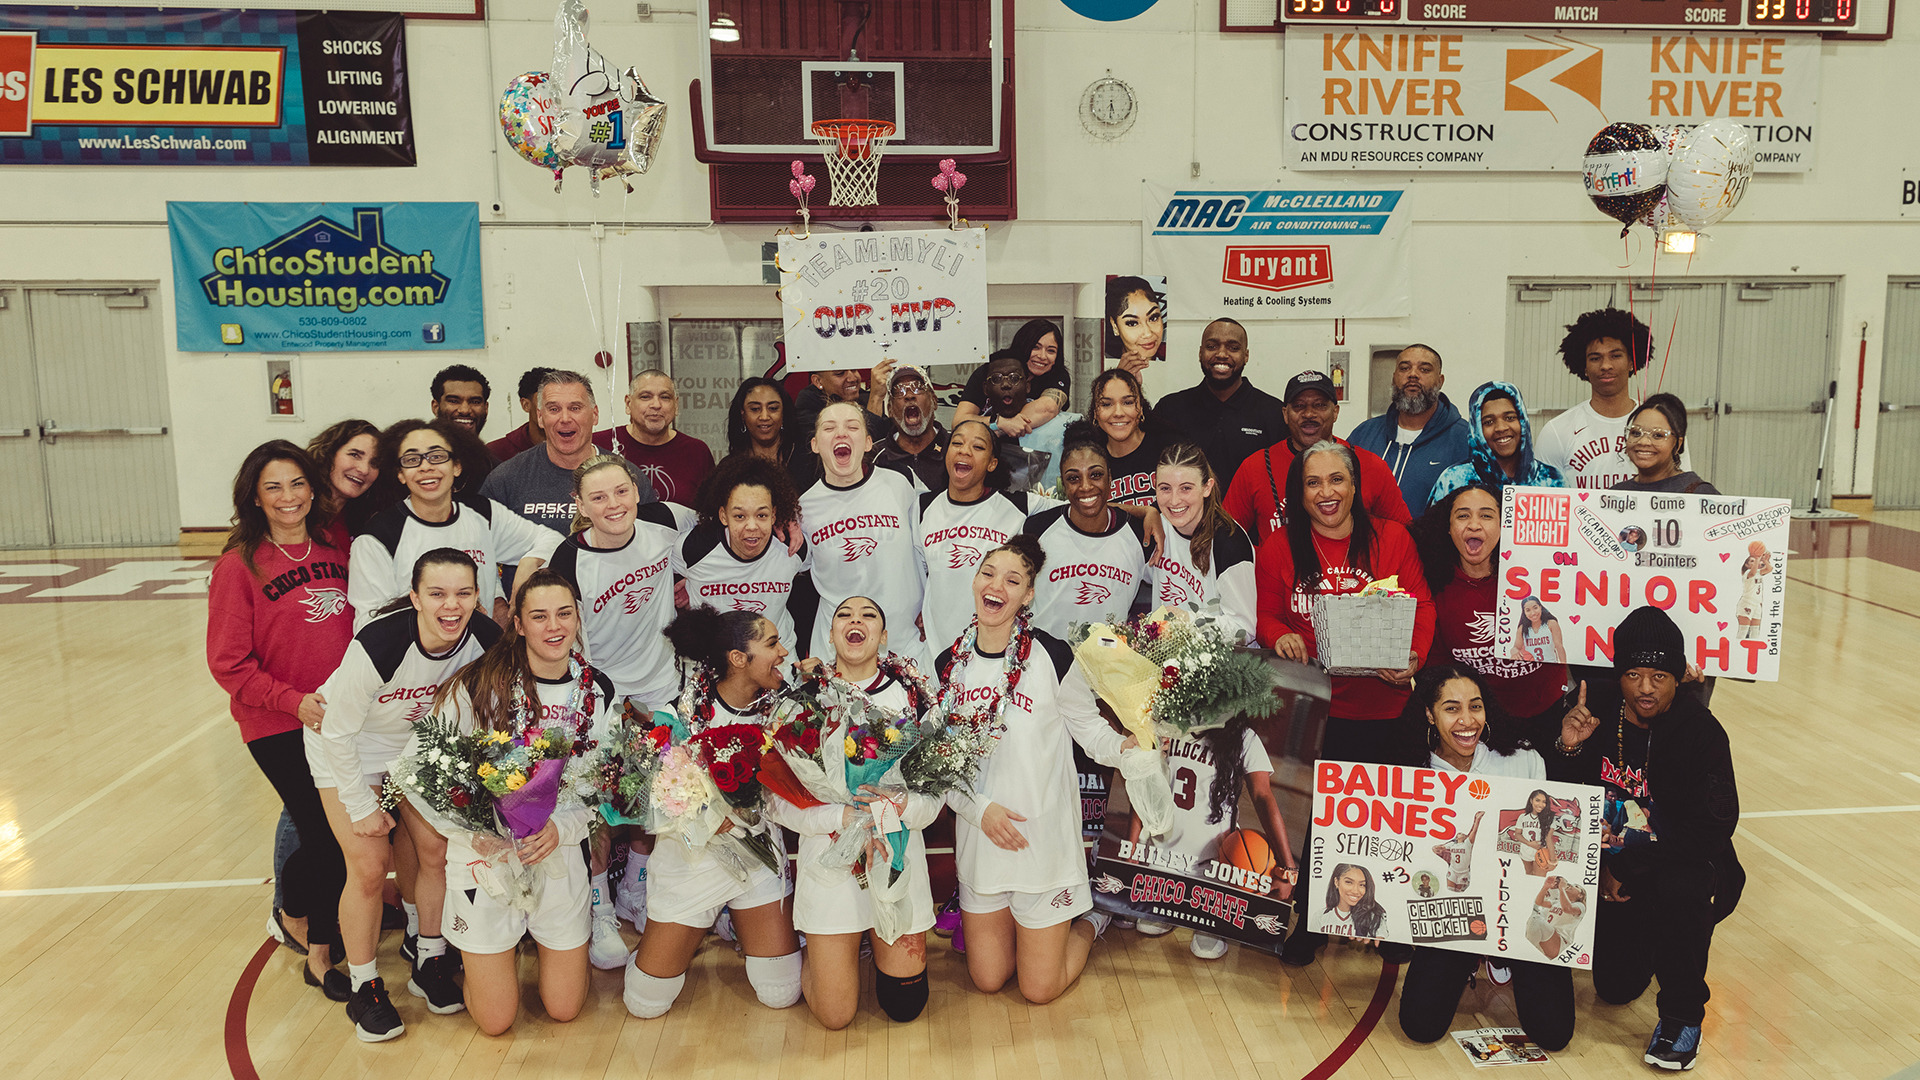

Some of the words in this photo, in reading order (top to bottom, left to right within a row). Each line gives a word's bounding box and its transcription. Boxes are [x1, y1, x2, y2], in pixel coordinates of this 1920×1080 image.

[1424, 4, 1466, 19] SCORE
[1555, 6, 1598, 20] MATCH
[1684, 8, 1726, 22] SCORE
[322, 40, 382, 56] SHOCKS
[1323, 33, 1464, 72] KNIFE
[1650, 36, 1786, 75] KNIFE
[44, 68, 103, 103] LES
[113, 69, 272, 106] SCHWAB
[327, 71, 382, 86] LIFTING
[1321, 78, 1464, 116] RIVER
[1648, 80, 1784, 118] RIVER
[318, 101, 397, 116] LOWERING
[583, 98, 620, 120] YOU'RE
[316, 130, 404, 145] ALIGNMENT
[589, 110, 626, 150] #1
[1291, 123, 1494, 141] CONSTRUCTION
[79, 134, 247, 151] www.LesSchwab.com
[1301, 152, 1317, 162] AN
[1321, 152, 1348, 162] MDU
[1351, 152, 1423, 162] RESOURCES
[1426, 152, 1484, 162] COMPANY
[1754, 152, 1801, 163] OMPANY
[1156, 199, 1247, 228] MAC
[1263, 195, 1383, 209] McCLELLAND
[1250, 221, 1271, 230] AIR
[1276, 221, 1359, 230] CONDITIONING
[212, 246, 434, 277] ChicoStudent
[798, 238, 879, 288] TEAM
[889, 236, 964, 277] MYLI
[1240, 253, 1318, 280] bryant
[216, 279, 435, 313] Housing.com
[852, 276, 910, 302] #20
[1223, 296, 1254, 307] Heating
[1257, 297, 1263, 305] &
[1265, 296, 1296, 307] Cooling
[1298, 296, 1332, 306] Systems
[299, 317, 367, 326] 530-809-0802
[812, 303, 875, 339] OUR
[254, 329, 411, 340] www.ChicoStudentHousing.com
[713, 377, 743, 389] KNO
[1569, 436, 1609, 473] CHICO
[1576, 473, 1638, 490] WILDCA
[1504, 487, 1515, 502] Go
[1600, 495, 1636, 513] Single
[1651, 496, 1685, 510] Game
[1700, 499, 1745, 516] Record
[523, 503, 578, 514] BASKE
[1517, 496, 1568, 520] SHINE
[1516, 520, 1567, 544] BRIGHT
[1581, 525, 1610, 555] HOLDER
[1654, 519, 1680, 546] 10
[1736, 520, 1780, 539] HOLDER
[1553, 551, 1578, 566] ON
[1649, 552, 1697, 568] Pointers
[262, 567, 311, 602] CHICO
[310, 561, 349, 584] STA
[1326, 566, 1374, 583] CALIFORN
[1505, 566, 1718, 614] SENIOR
[1769, 600, 1781, 617] the
[1768, 620, 1781, 656] Bailey
[1585, 626, 1768, 676] NHT
[1478, 662, 1543, 679] SKETBALL
[1169, 738, 1214, 767] ILDCA
[1174, 766, 1197, 811] 3
[1317, 763, 1468, 805] BAILEY
[1313, 796, 1457, 840] JONES
[1588, 794, 1601, 835] HOLDER
[1312, 836, 1325, 879] CHICO!
[1370, 836, 1380, 857] 2023
[1118, 840, 1199, 874] BAILEY
[1204, 859, 1273, 895] JONES
[1455, 854, 1461, 864] 3
[1583, 843, 1599, 886] RECORD
[1382, 866, 1411, 884] #3
[1130, 873, 1187, 905] CHICO
[1190, 885, 1249, 930] STATE
[1409, 900, 1483, 918] CERTIFIED
[1497, 857, 1512, 952] WILDCATS
[1153, 906, 1217, 928] BASKETBALL
[1412, 919, 1468, 936] BUCKET
[1558, 943, 1583, 963] BAE
